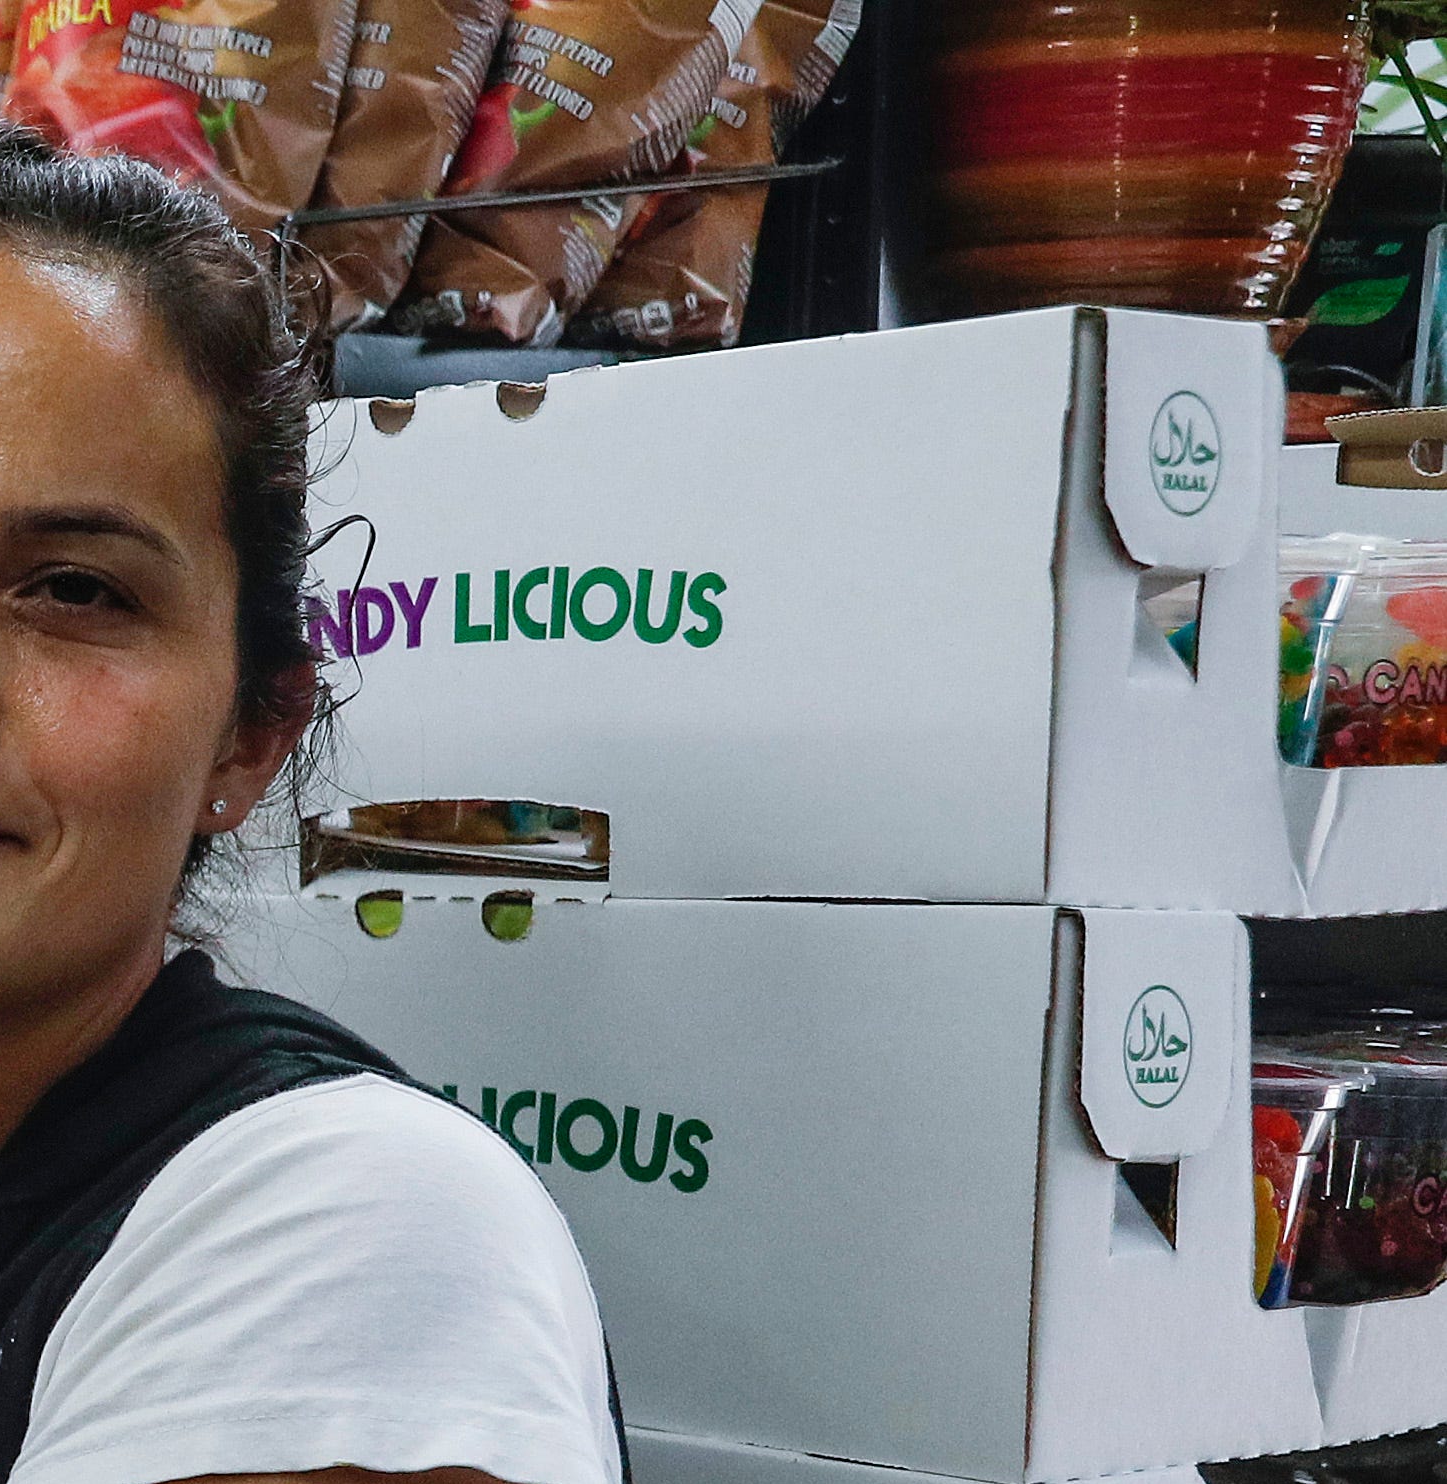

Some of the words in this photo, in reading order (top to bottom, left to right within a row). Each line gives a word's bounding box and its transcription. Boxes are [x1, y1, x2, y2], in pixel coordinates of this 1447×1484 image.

[560, 38, 614, 78] PEPPER
[526, 71, 594, 122] FLAVORED
[1154, 410, 1216, 467] حلال
[1163, 473, 1207, 492] HALAL
[307, 576, 439, 660] NDY
[454, 566, 728, 649] LICIOUS
[1363, 658, 1447, 704] CAN
[1127, 1003, 1188, 1062] حلال
[1135, 1066, 1179, 1083] HALAL
[443, 1084, 714, 1193] ICIOUS
